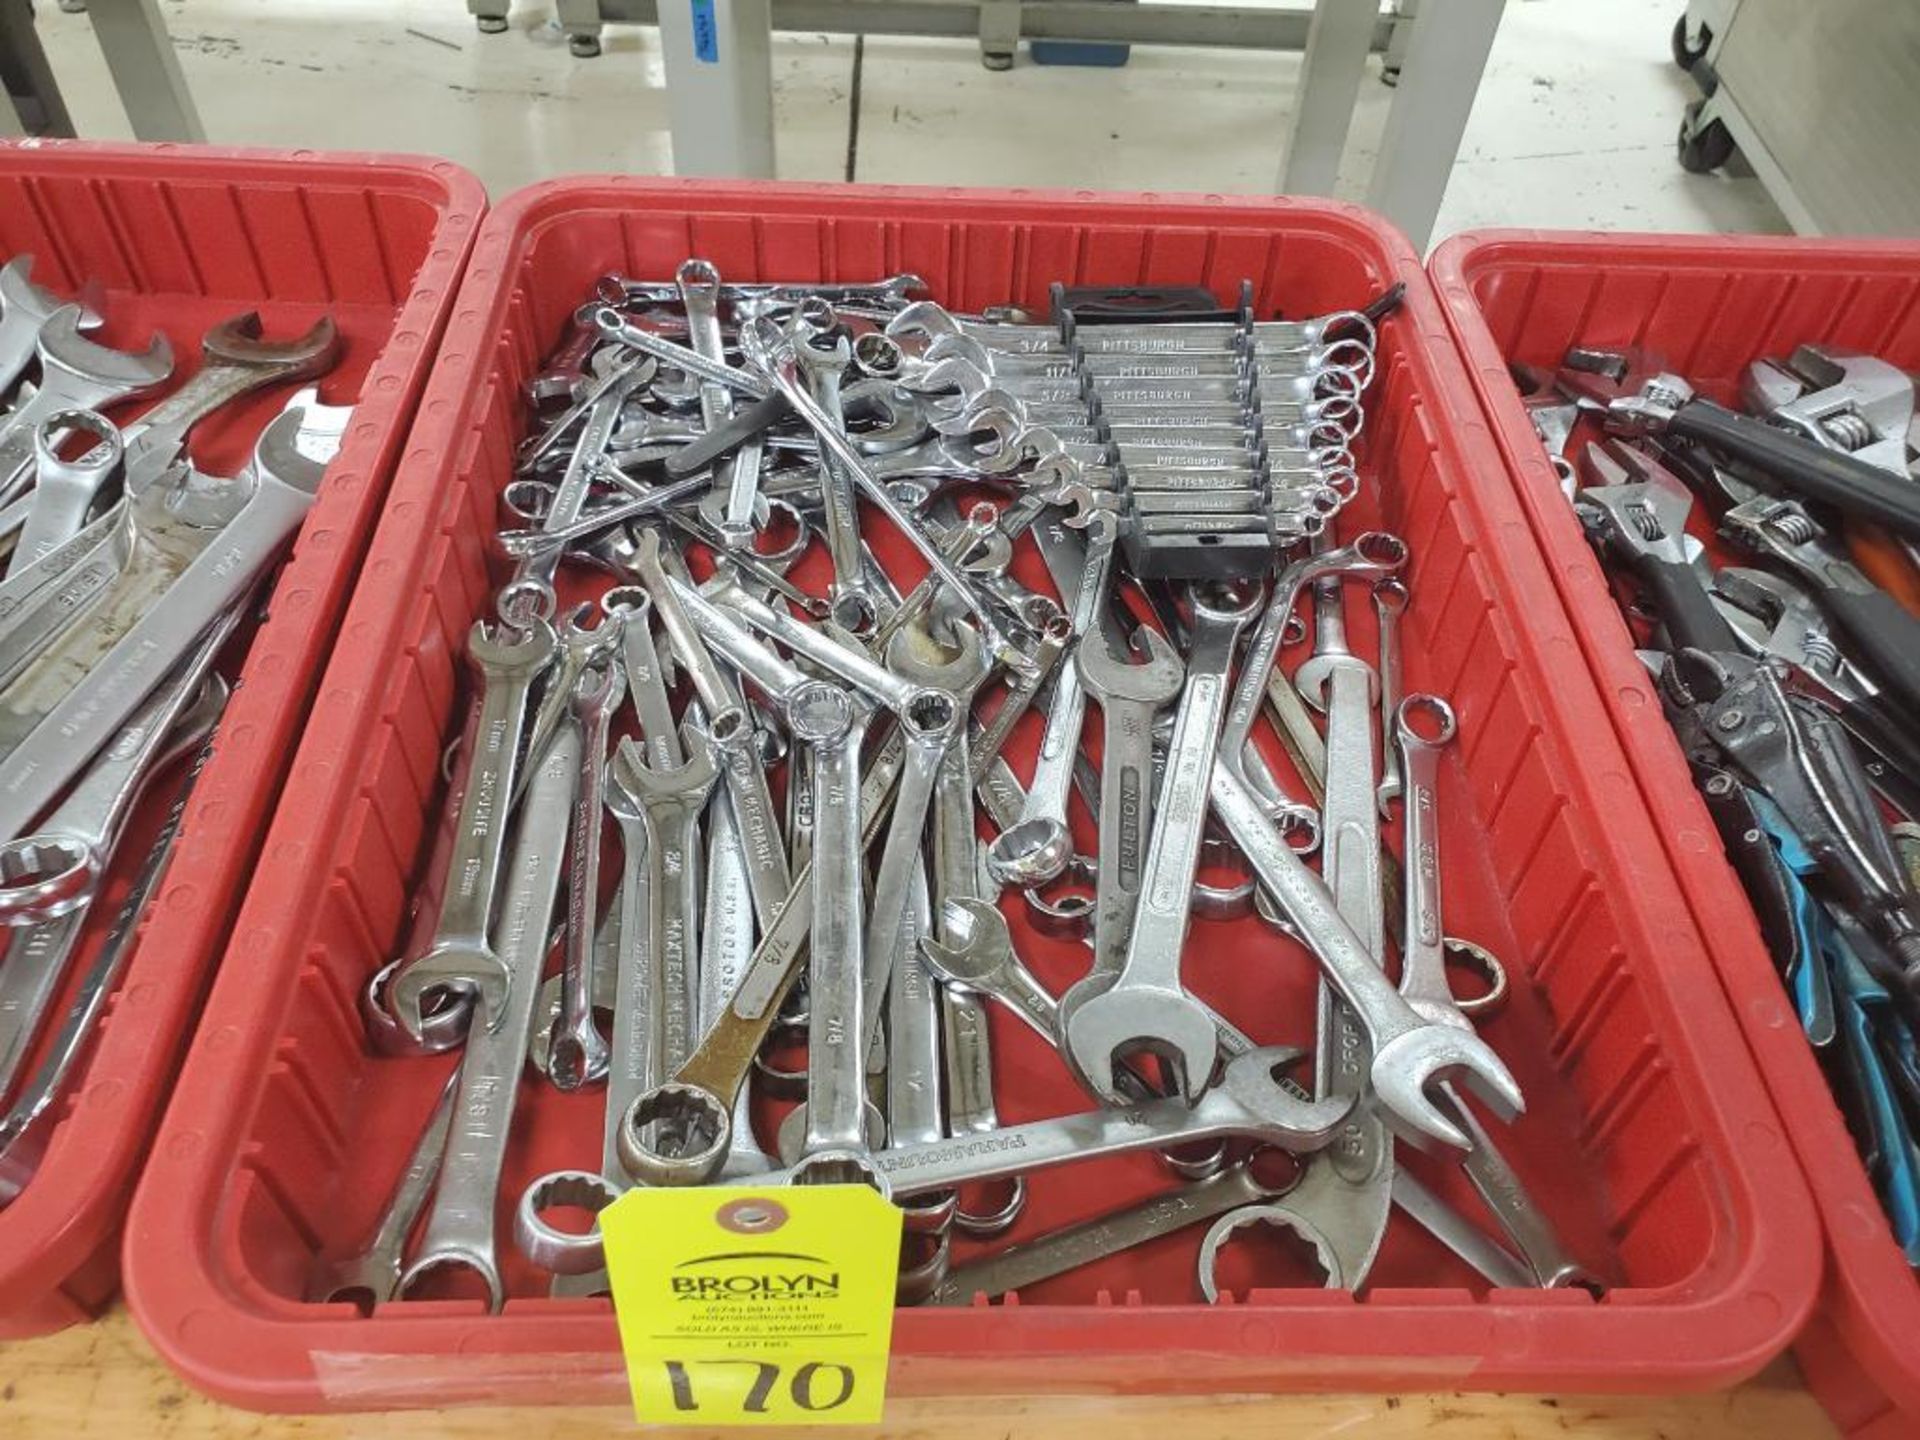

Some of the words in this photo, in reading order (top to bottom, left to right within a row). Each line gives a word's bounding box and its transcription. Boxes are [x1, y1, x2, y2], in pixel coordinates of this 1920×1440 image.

[1102, 339, 1185, 350] PITTSBURGH
[1119, 366, 1198, 376] PITTSBURGH
[1113, 389, 1191, 400] PITTSBURGH
[1134, 415, 1208, 426] PITTSBURGH
[1131, 437, 1203, 447] PITTSBURGH
[1156, 455, 1225, 466] PITTSBURGH
[742, 793, 776, 871] MECHANIC
[1122, 789, 1137, 870] FULTON
[826, 1018, 844, 1044] 7/8
[672, 1272, 839, 1293] BROLYN
[676, 1290, 841, 1301] AUCTIONS
[727, 1340, 758, 1349] LOT
[664, 1359, 855, 1413] 170
